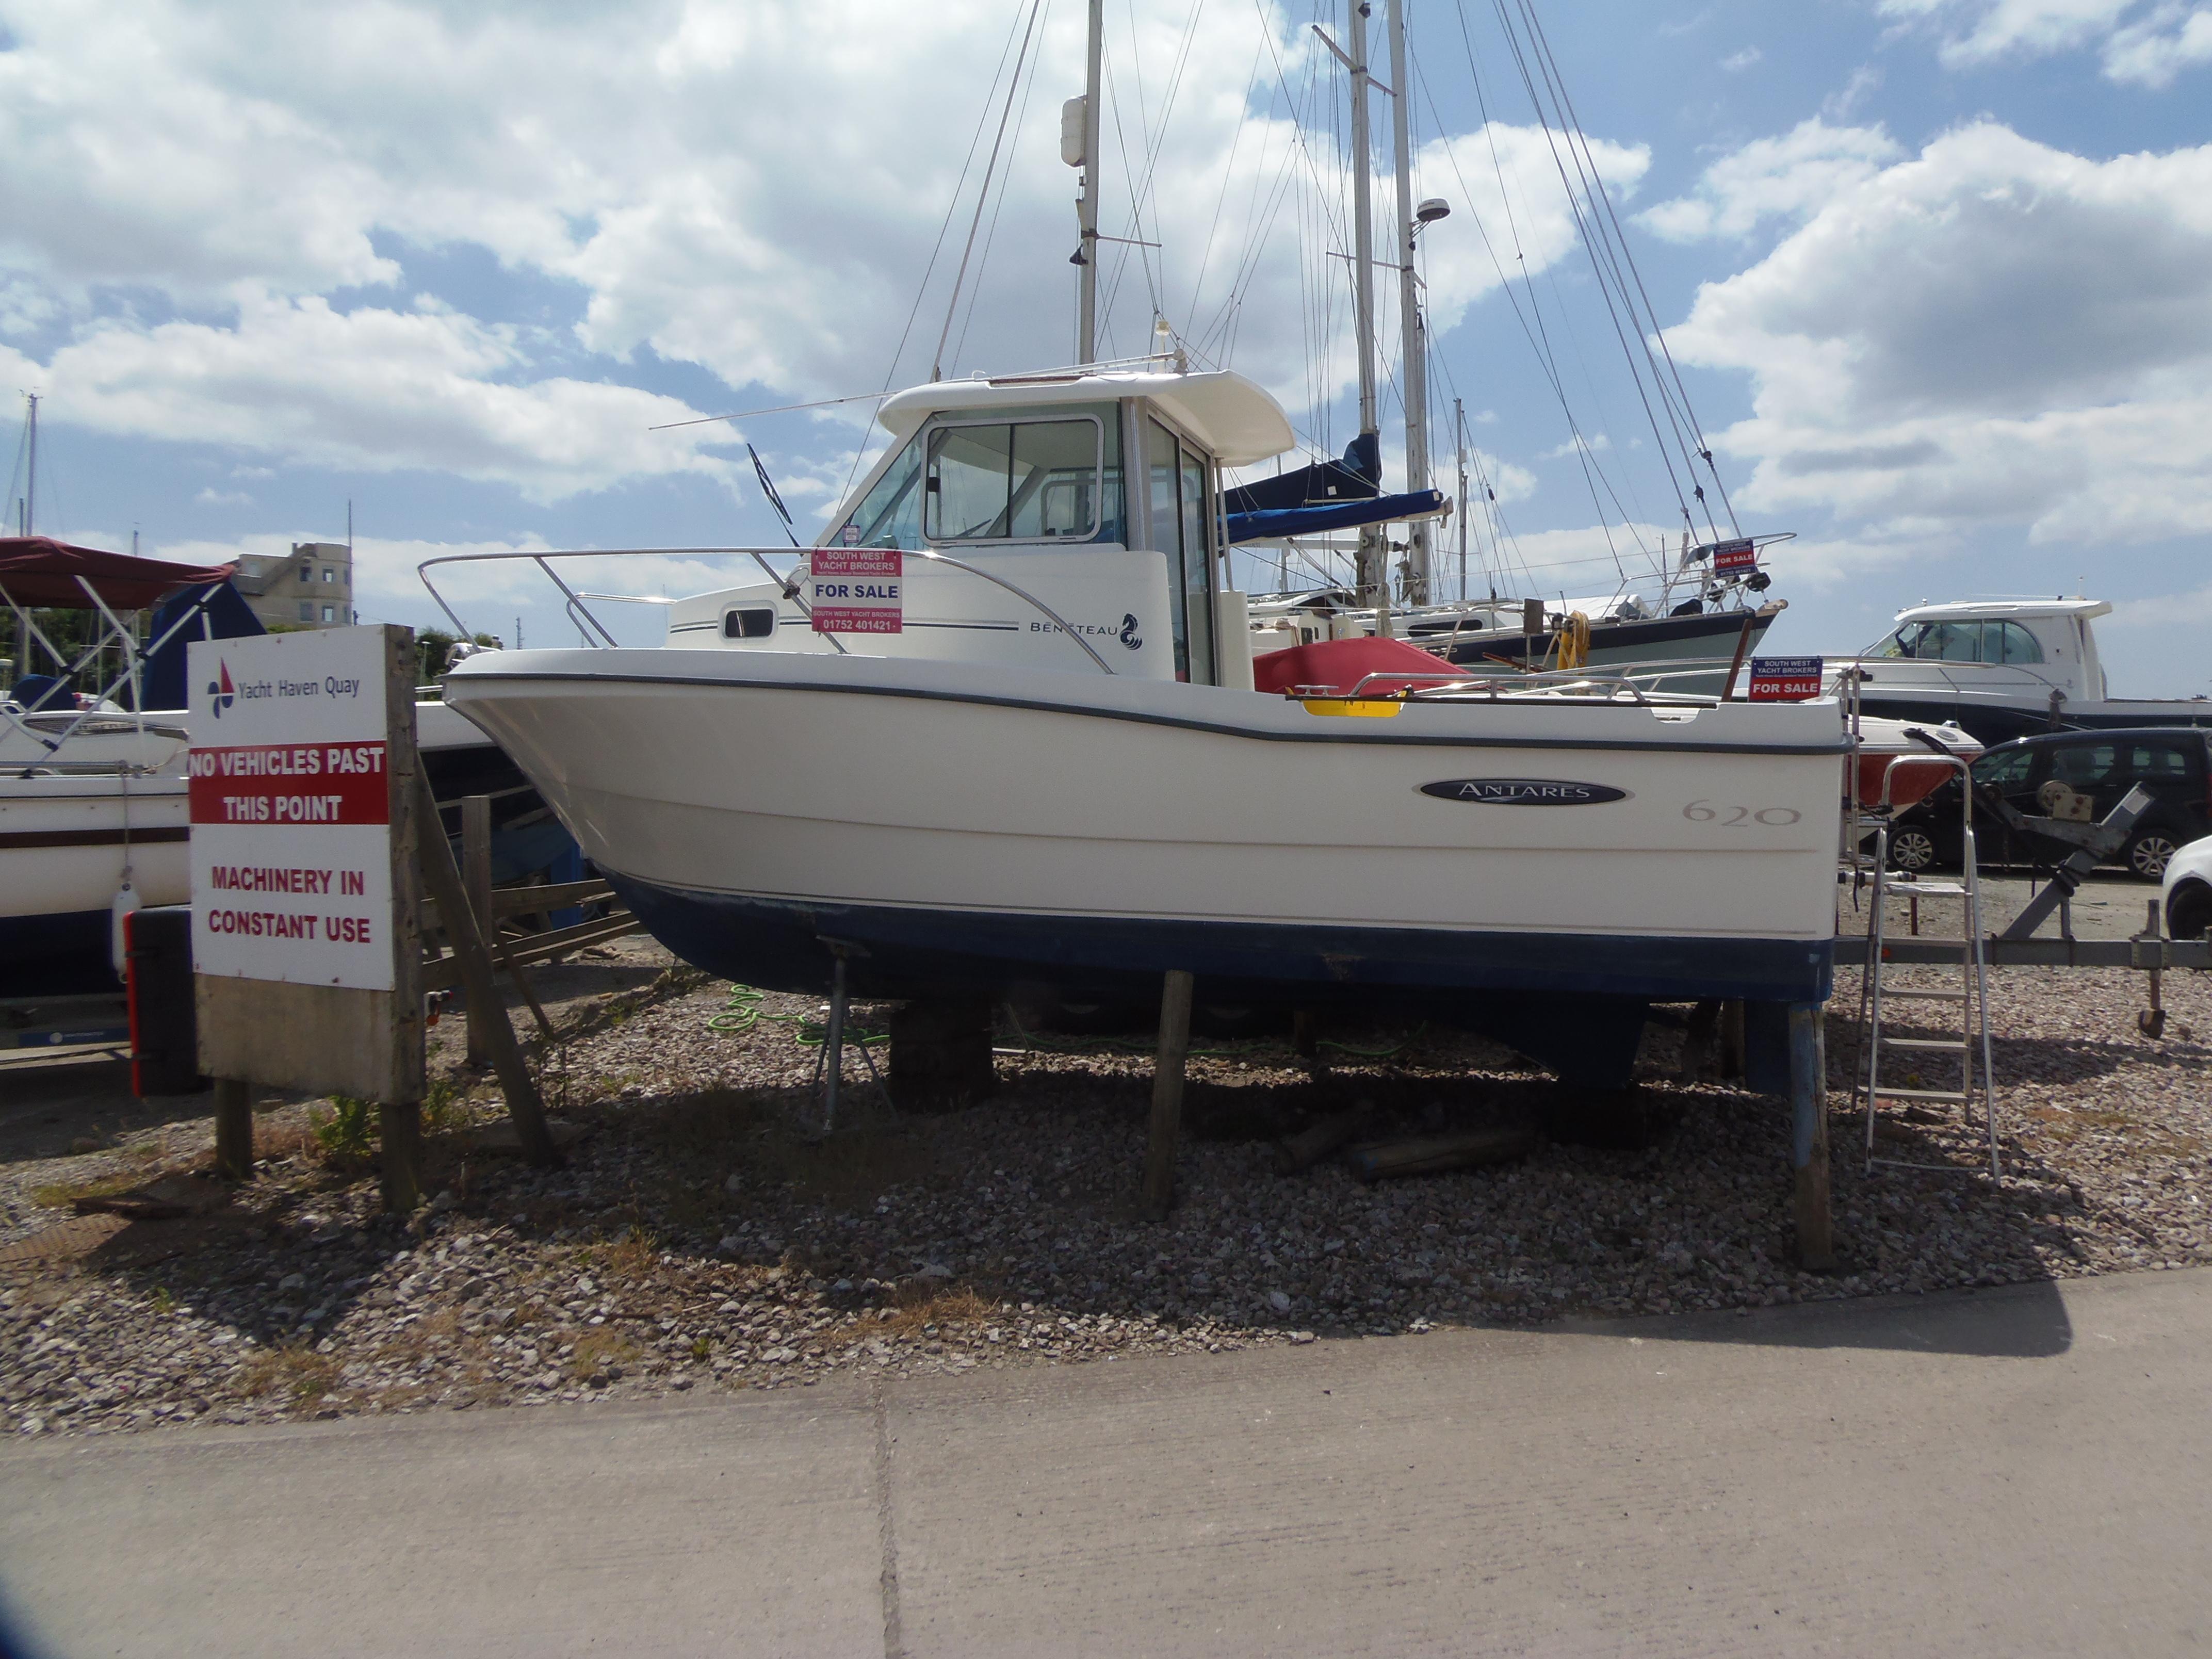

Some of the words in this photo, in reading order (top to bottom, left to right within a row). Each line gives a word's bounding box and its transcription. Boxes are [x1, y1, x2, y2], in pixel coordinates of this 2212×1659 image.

[818, 561, 848, 570] YACHT
[850, 562, 894, 571] BROKERS
[826, 552, 857, 560] SOUTH
[860, 552, 886, 560] WEST
[815, 584, 850, 597] FOR
[854, 585, 899, 598] SALE
[823, 620, 853, 629] 01752
[855, 621, 890, 630] 401421
[238, 680, 272, 699] Yacht
[278, 679, 319, 697] Haven
[325, 676, 360, 698] Quay
[1753, 684, 1780, 693] FOR
[1783, 683, 1818, 693] SALE
[189, 753, 216, 777] NO
[220, 749, 321, 776] VEHICLES
[327, 747, 384, 774] PAST
[223, 796, 269, 821] THIS
[275, 795, 342, 821] POINT
[1682, 799, 1802, 827] 620
[212, 866, 332, 894] MACHINERY
[340, 870, 364, 896] IN
[209, 909, 318, 939] CONSTANT
[326, 916, 371, 944] USE
